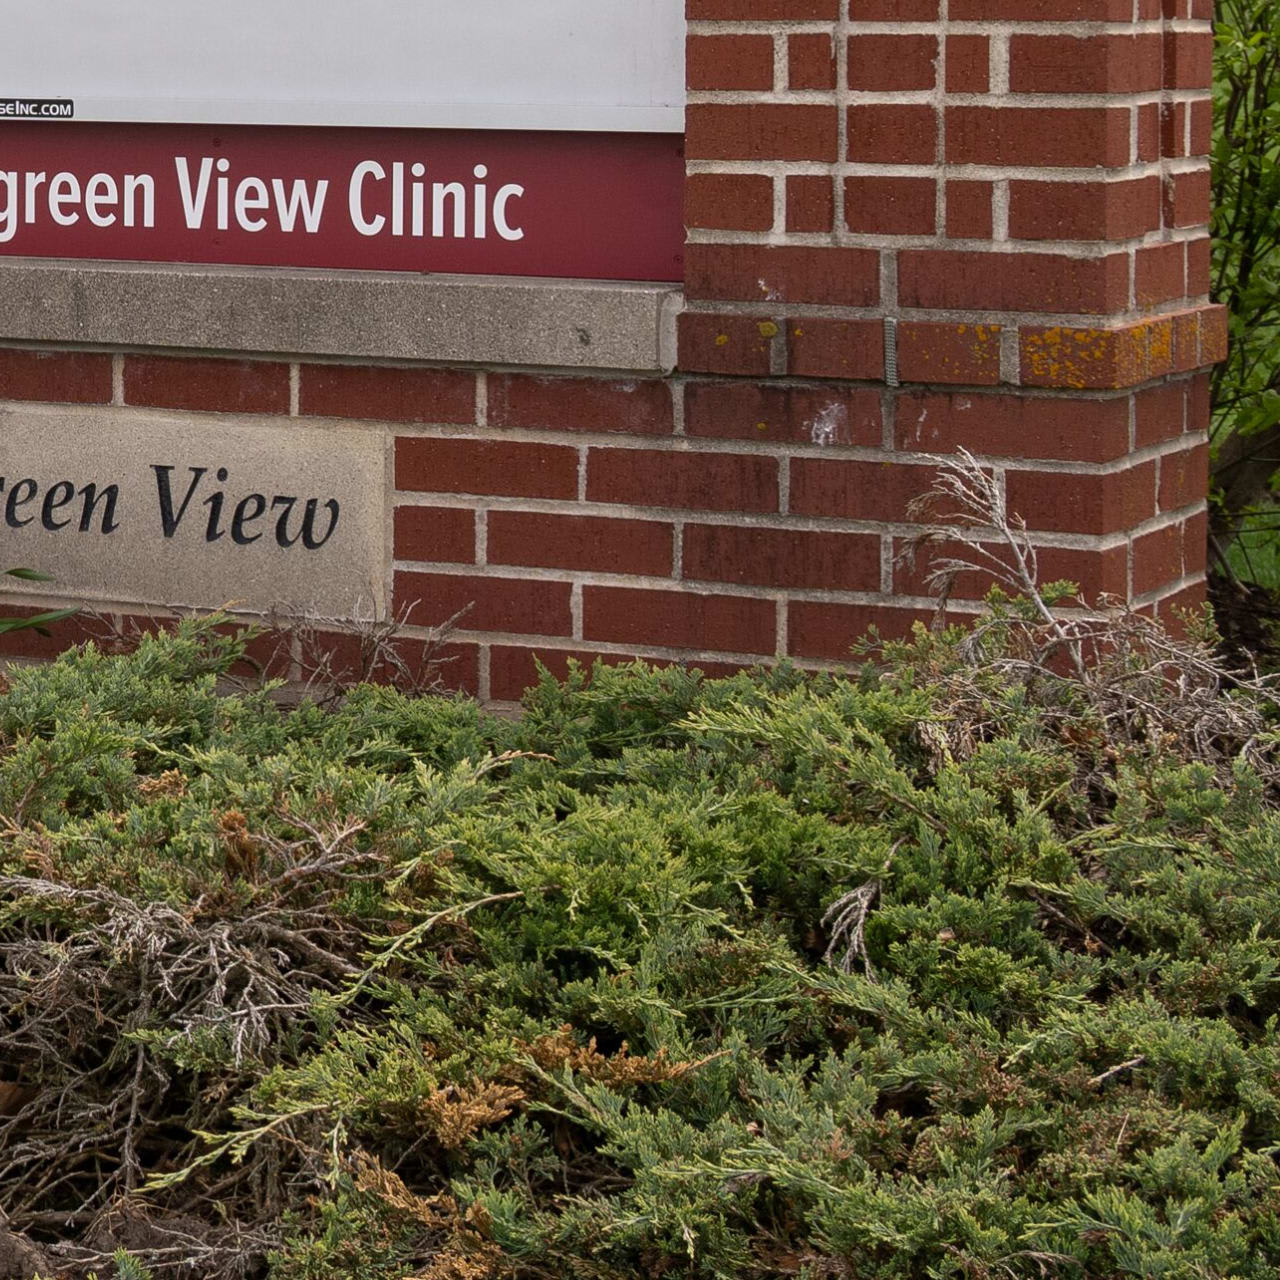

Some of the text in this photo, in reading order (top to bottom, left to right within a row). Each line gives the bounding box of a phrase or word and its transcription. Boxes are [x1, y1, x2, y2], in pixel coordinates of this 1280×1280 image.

[174, 156, 330, 234] View
[348, 160, 526, 242] Clinic
[149, 464, 340, 550] View
